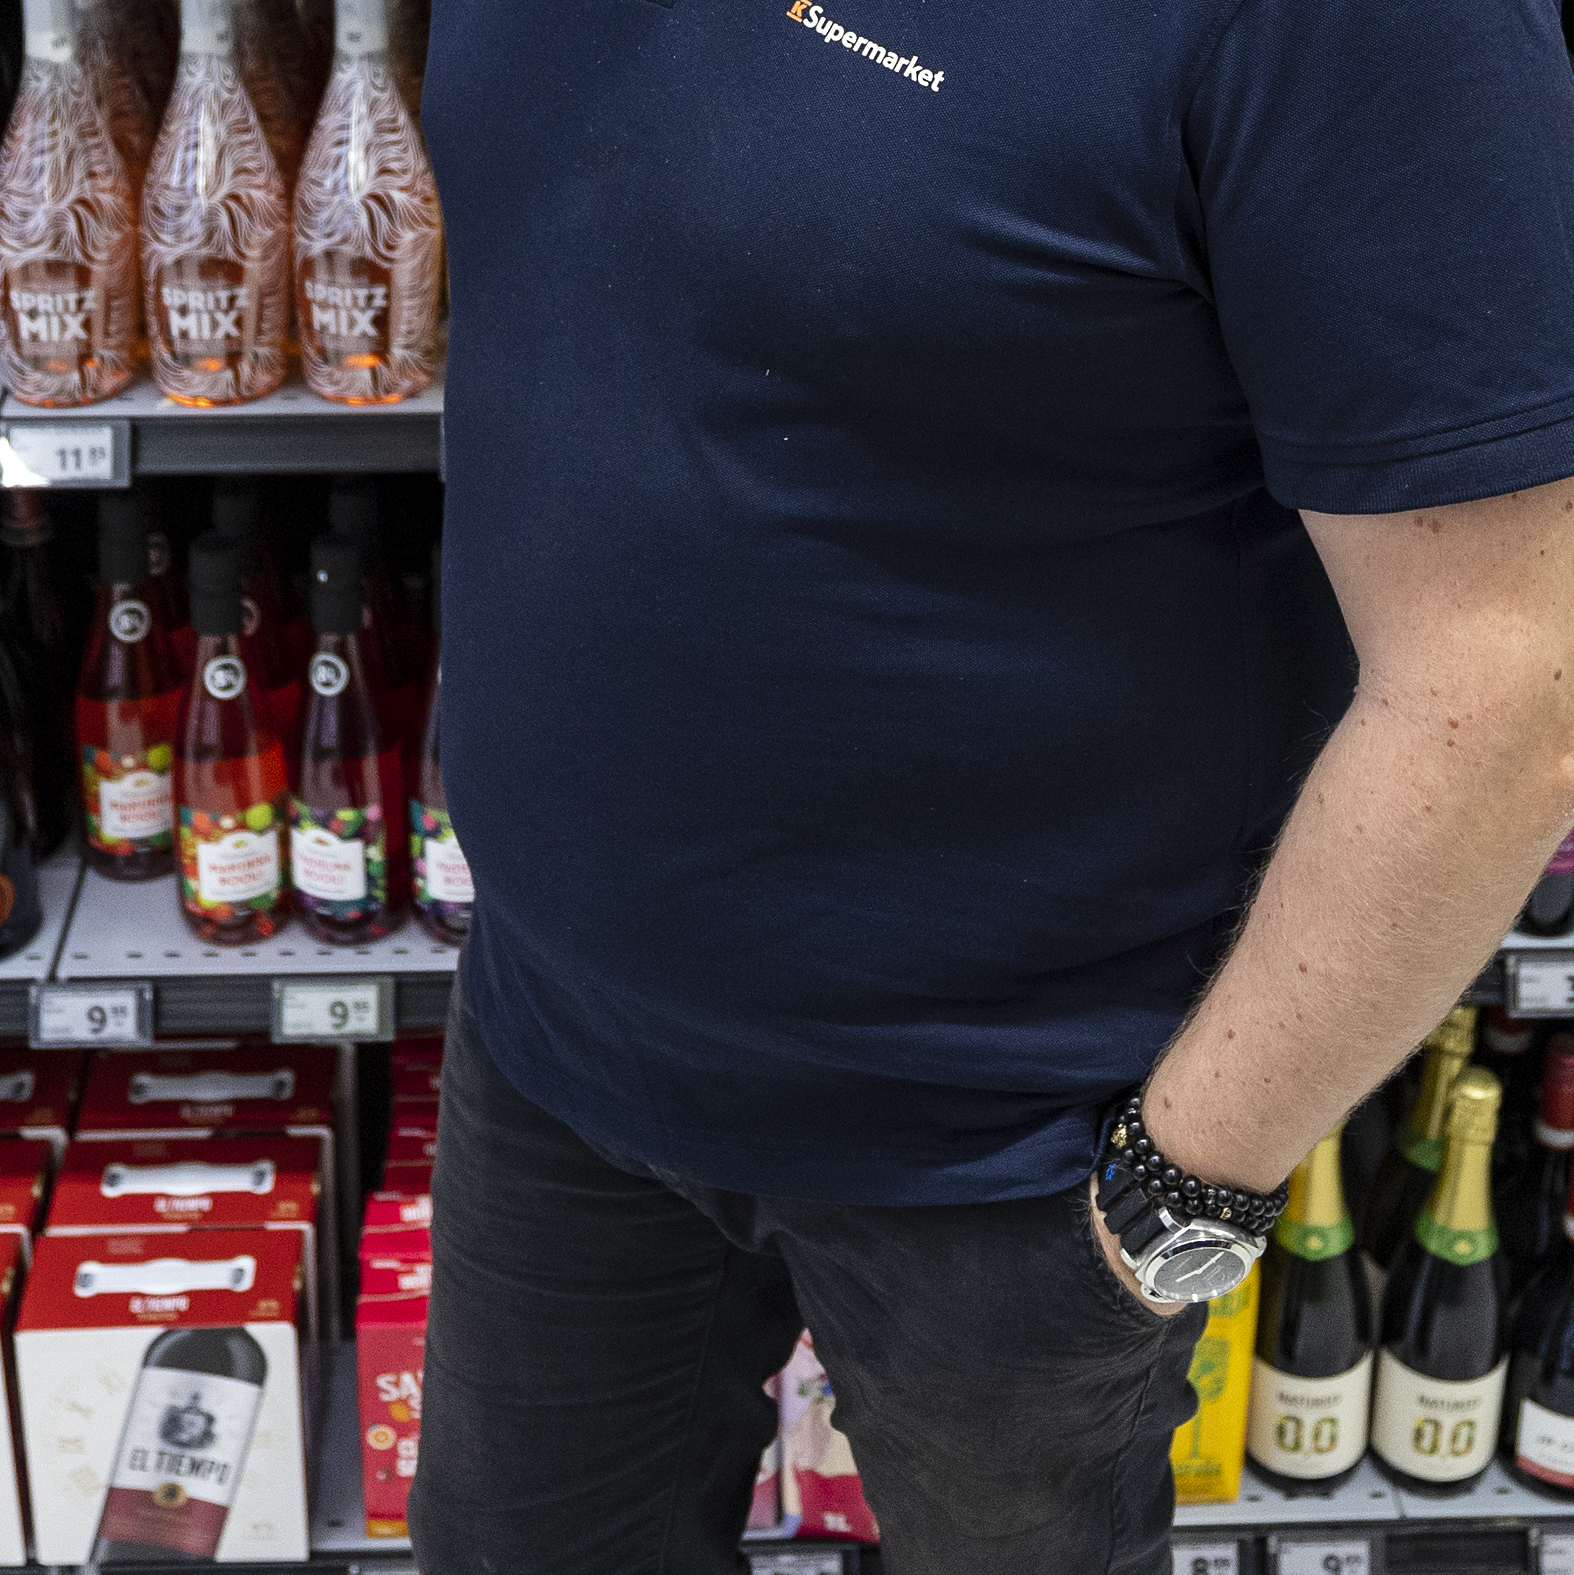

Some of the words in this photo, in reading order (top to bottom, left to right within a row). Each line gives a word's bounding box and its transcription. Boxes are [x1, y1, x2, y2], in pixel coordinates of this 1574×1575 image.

[803, 5, 944, 92] Supermarket
[9, 288, 96, 313] SPRITZ
[162, 288, 248, 312] SPRITZ
[306, 282, 387, 306] SPRITZ
[17, 310, 88, 341] MIX
[169, 310, 241, 340] MIX
[311, 305, 377, 338] MIX
[57, 447, 83, 471] 11
[86, 1005, 107, 1033] 9
[329, 1000, 349, 1028] 9
[131, 1449, 152, 1473] EL
[155, 1449, 228, 1487] TIEMPO
